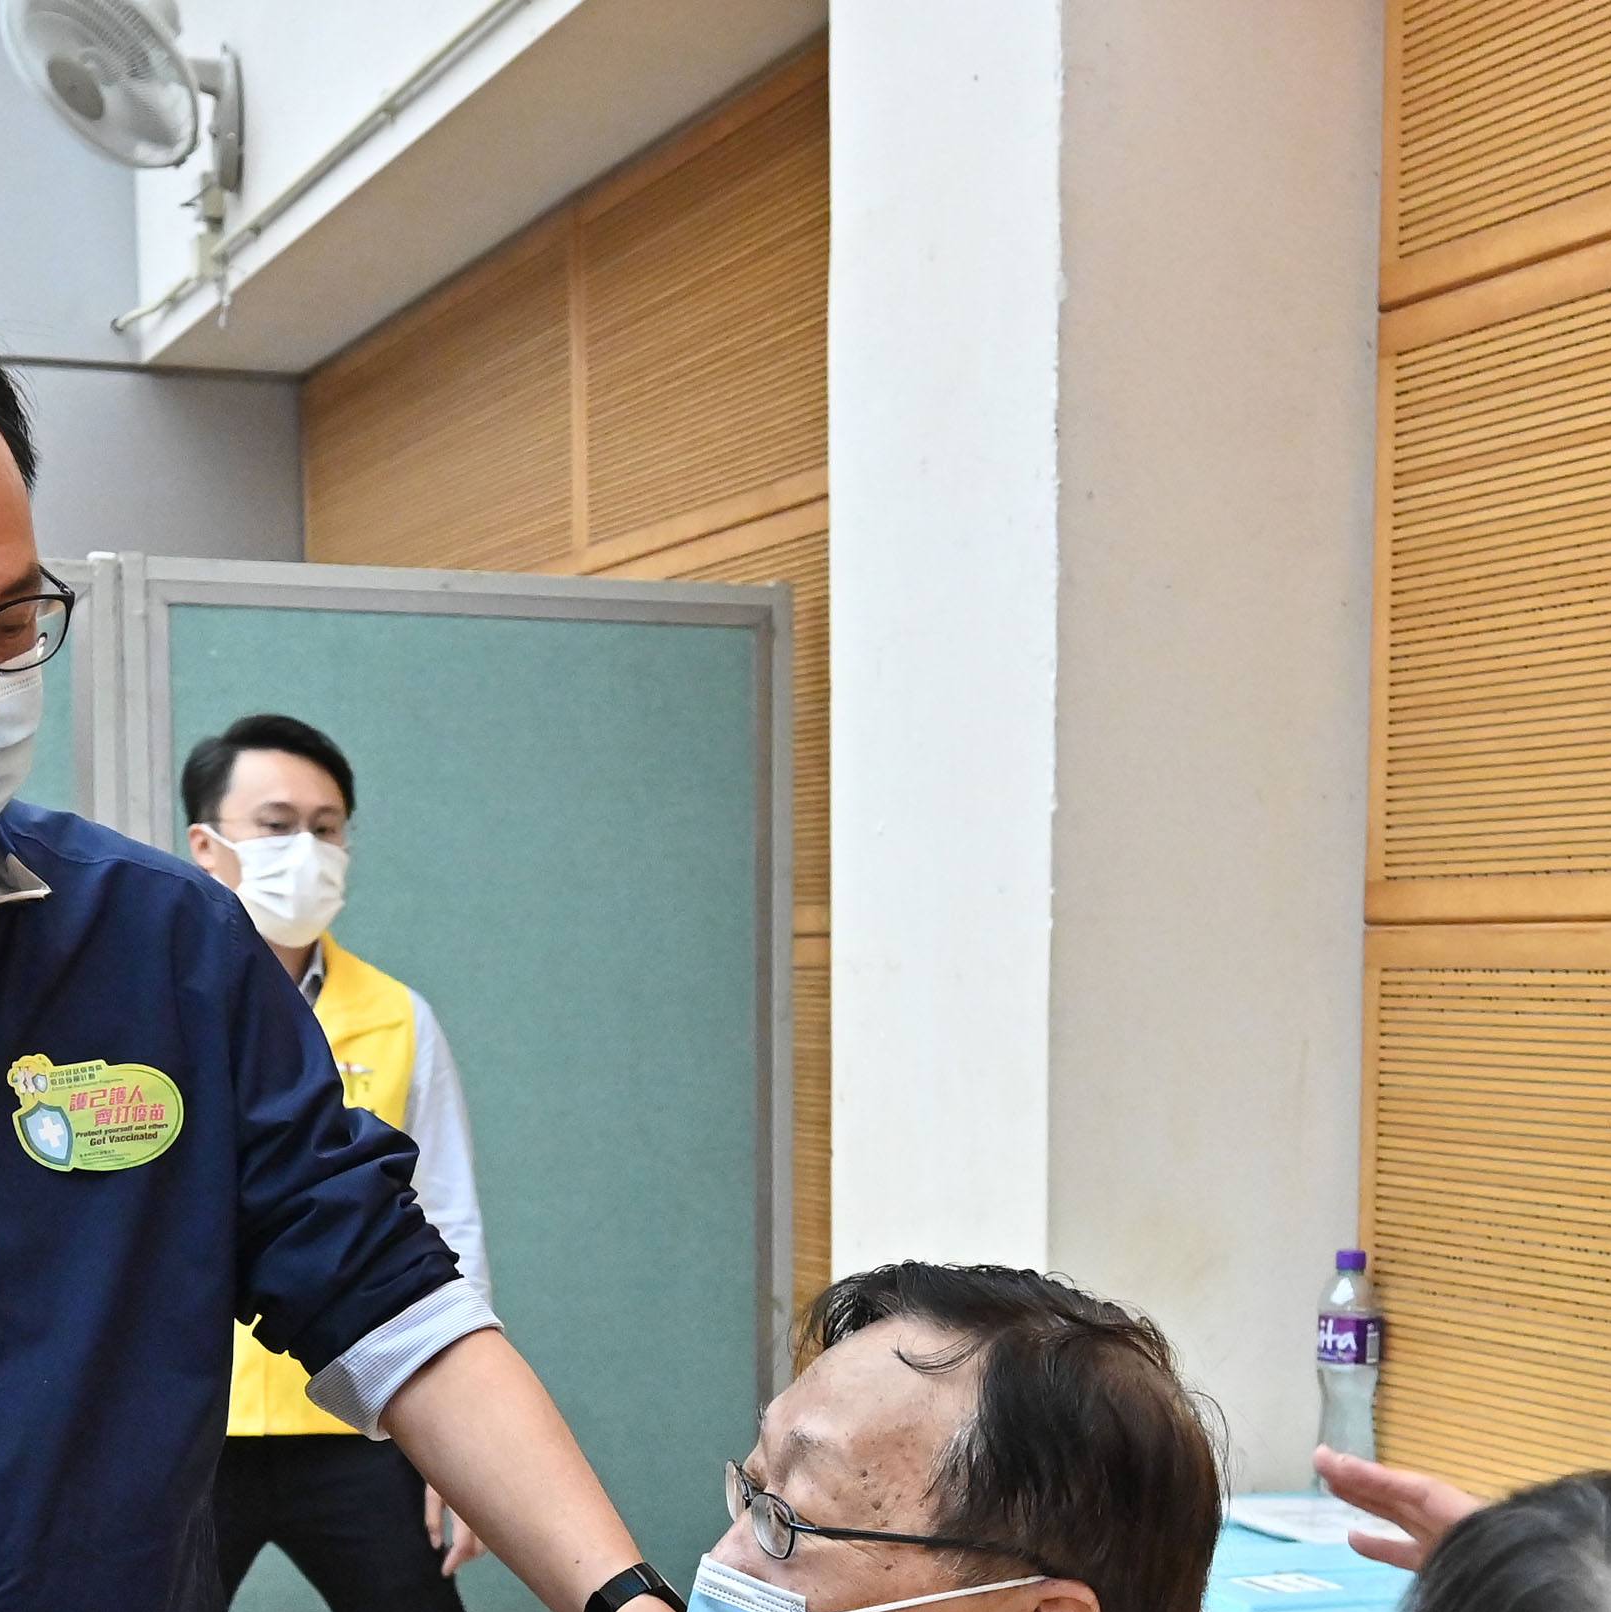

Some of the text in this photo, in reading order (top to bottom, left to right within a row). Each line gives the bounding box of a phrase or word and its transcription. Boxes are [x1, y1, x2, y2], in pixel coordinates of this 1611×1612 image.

[69, 1085, 145, 1112] 護己護人
[75, 1129, 102, 1139] Protect
[104, 1125, 133, 1136] yourself
[90, 1131, 158, 1147] Get Vaccinated
